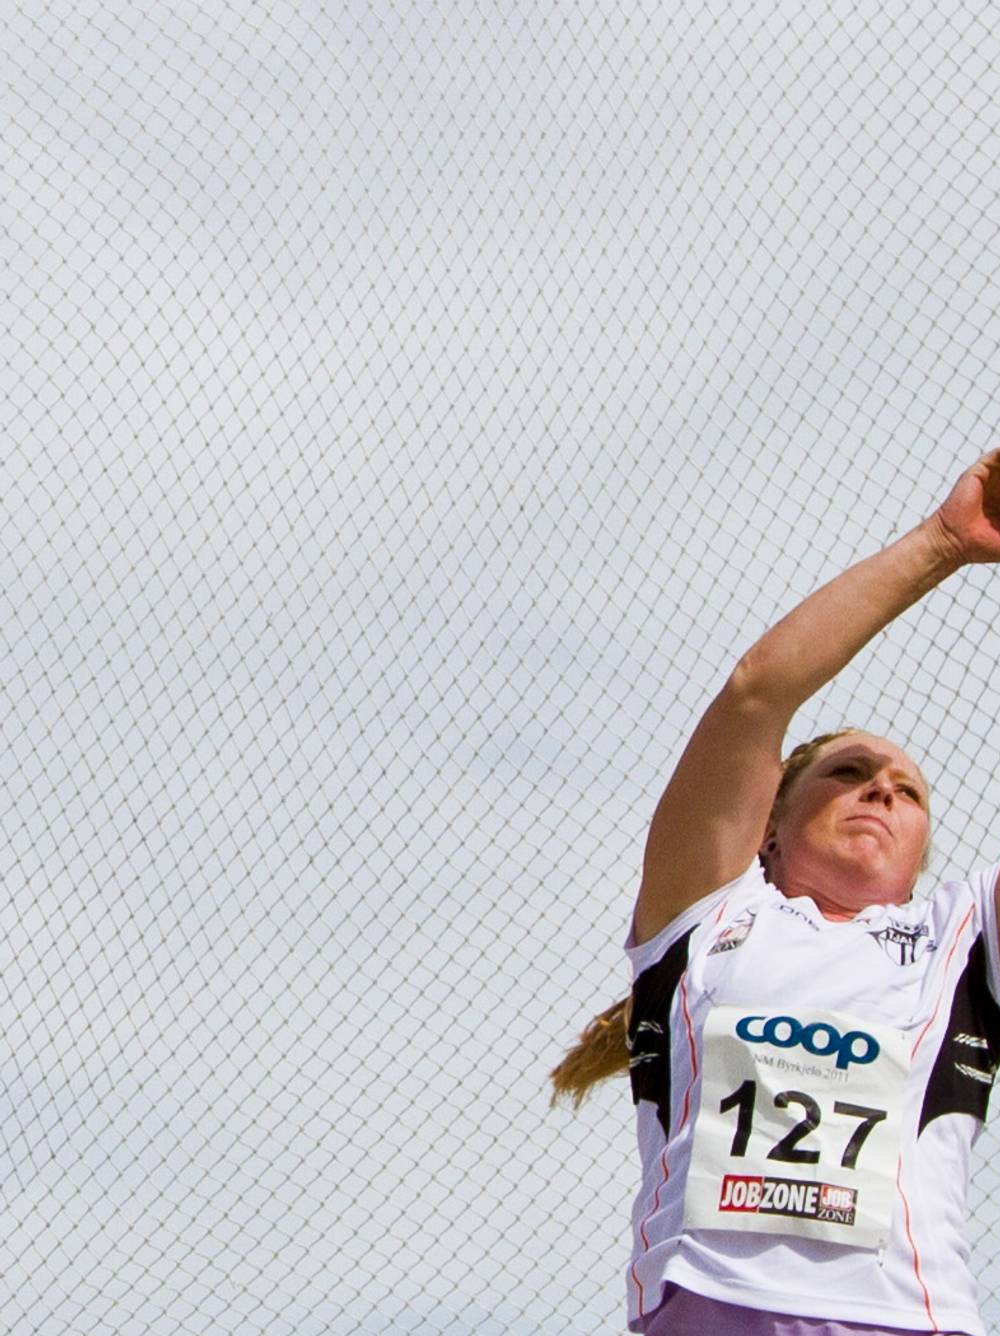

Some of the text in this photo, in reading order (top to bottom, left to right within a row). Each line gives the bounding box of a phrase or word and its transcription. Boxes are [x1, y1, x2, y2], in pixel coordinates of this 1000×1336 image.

[735, 1015, 880, 1070] coop
[823, 1067, 849, 1083] 2011
[719, 1080, 888, 1170] 127
[822, 1187, 854, 1209] JOB
[817, 1208, 854, 1224] ZONE
